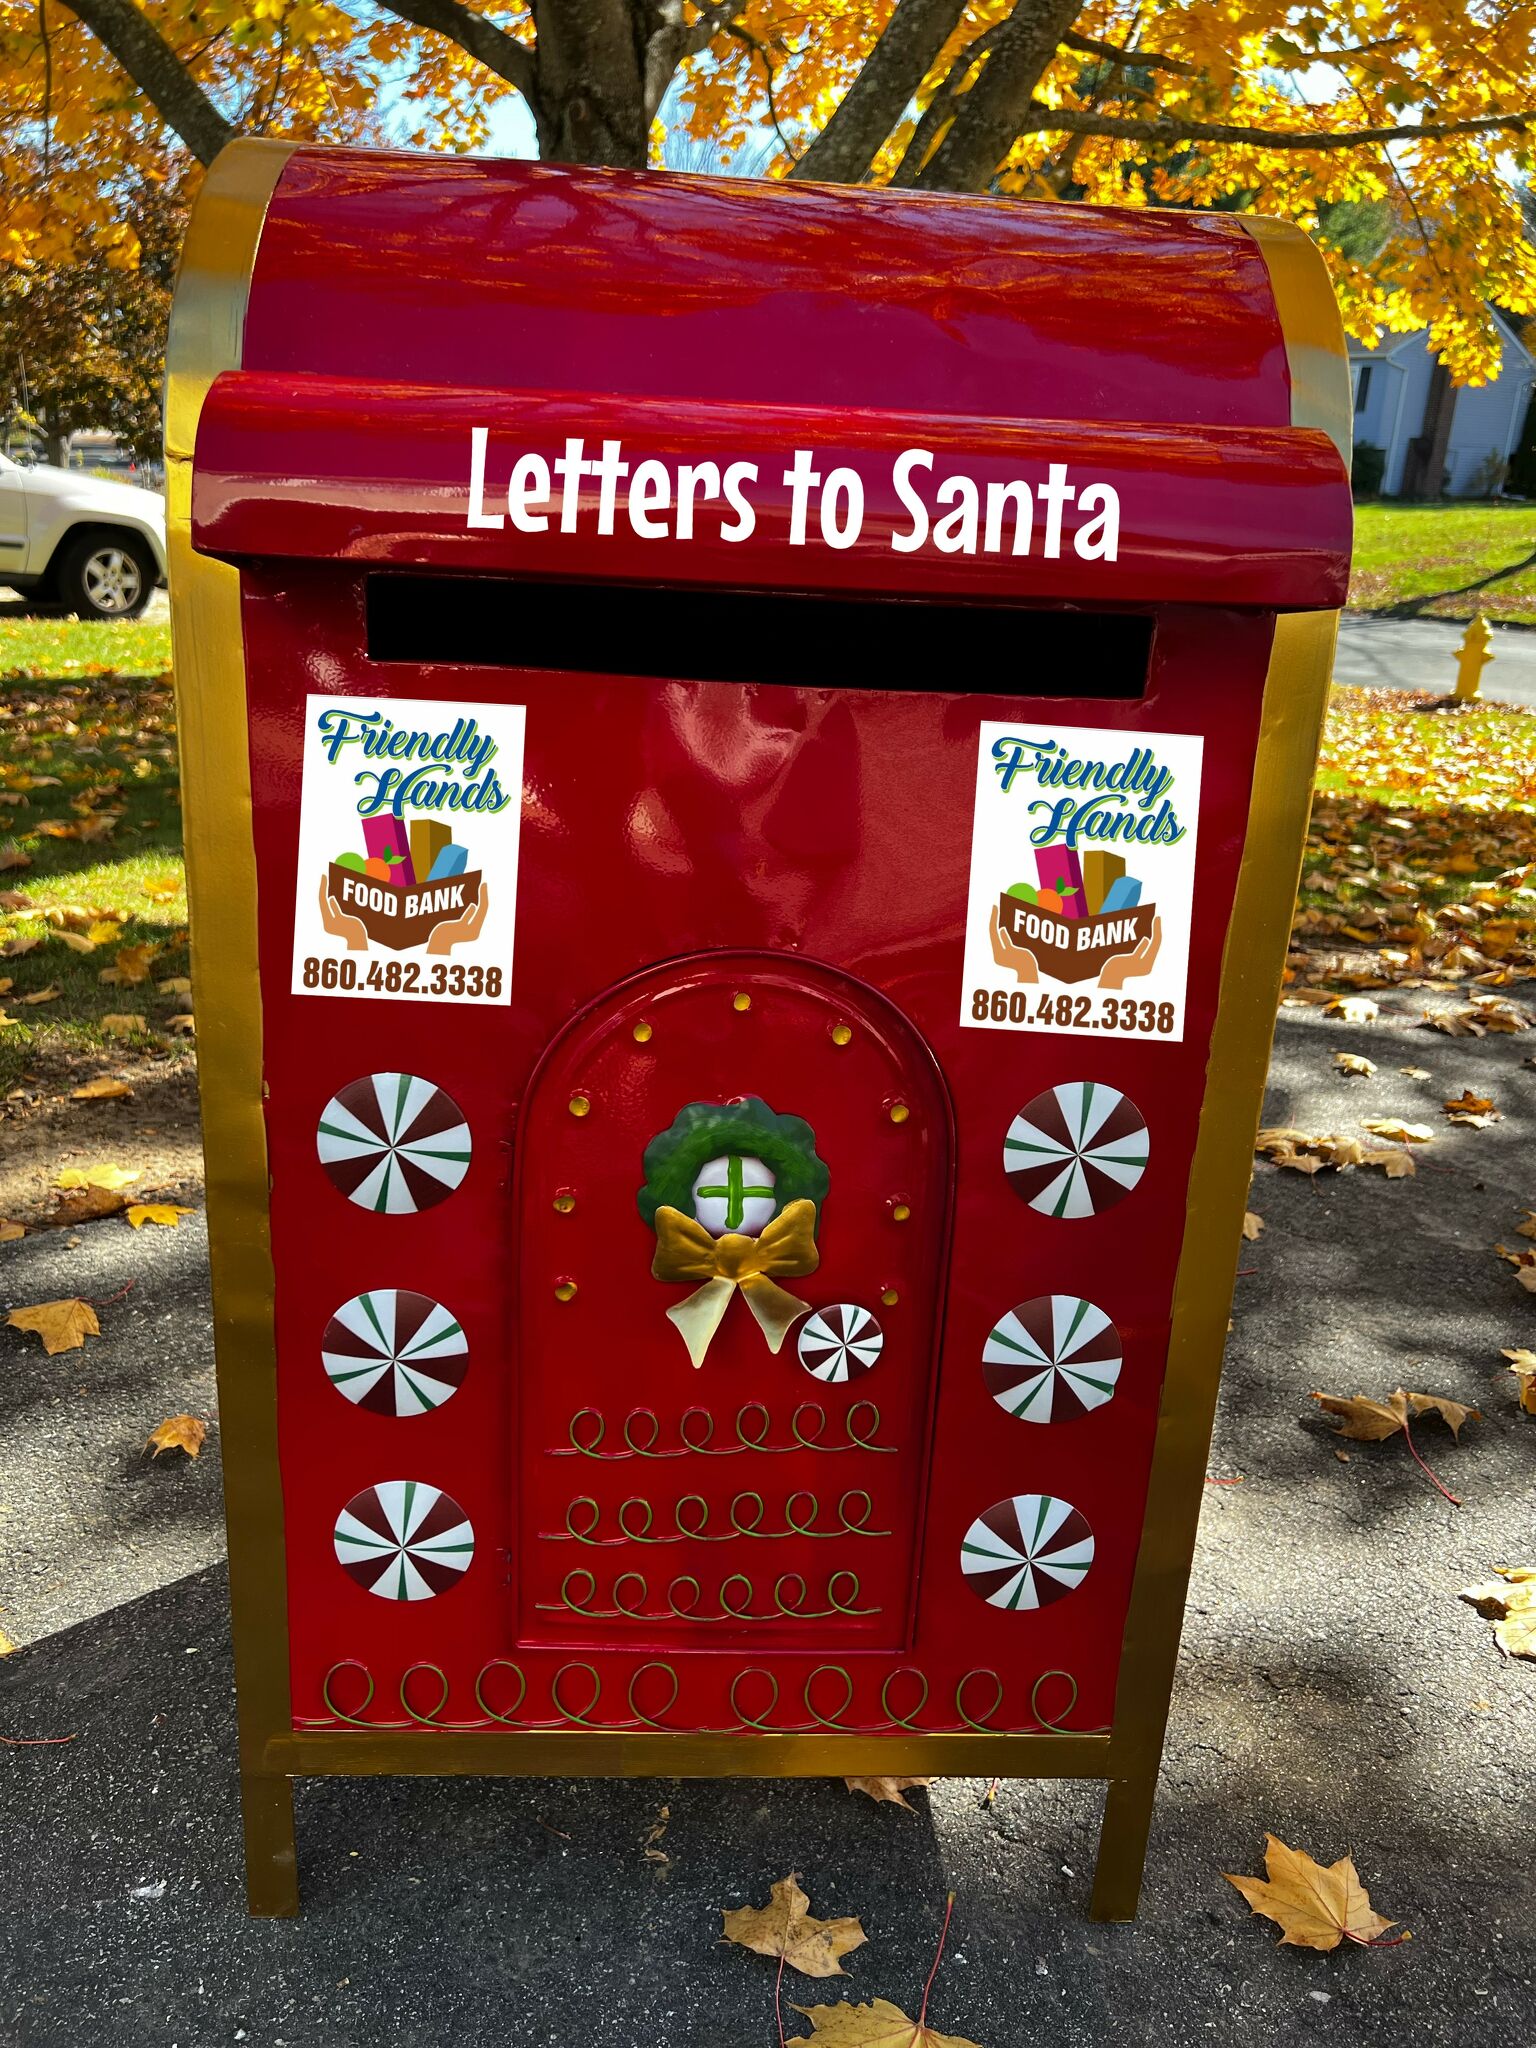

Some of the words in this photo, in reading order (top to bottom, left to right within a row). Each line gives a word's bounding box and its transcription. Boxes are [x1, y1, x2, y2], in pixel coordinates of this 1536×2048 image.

[466, 427, 760, 543] Letters
[783, 449, 865, 549] to
[891, 448, 1121, 562] Santa
[317, 709, 499, 777] Friendly
[354, 764, 512, 819] Hands
[991, 736, 1175, 808] Friendly
[1027, 794, 1187, 849] Hands
[342, 877, 398, 917] FOOD
[404, 884, 466, 919] BANK
[1013, 908, 1070, 950] FOOD
[1076, 917, 1139, 952] BANK
[303, 957, 502, 998] 860.482.3338
[971, 989, 1175, 1034] 860.482.3338
